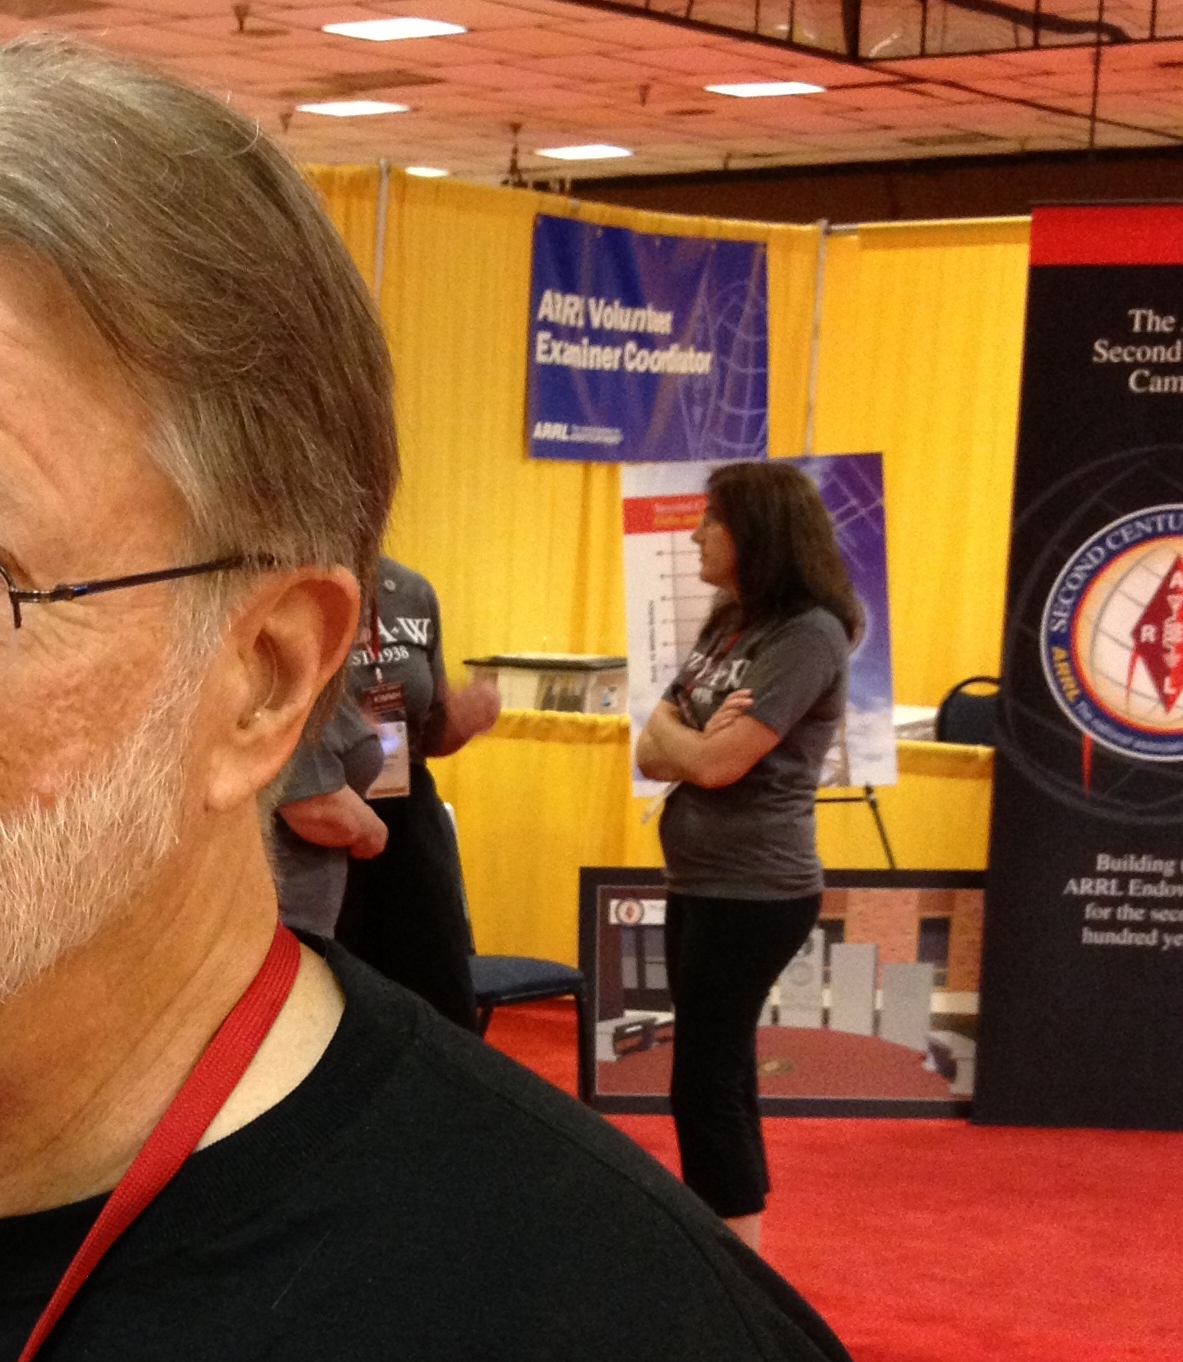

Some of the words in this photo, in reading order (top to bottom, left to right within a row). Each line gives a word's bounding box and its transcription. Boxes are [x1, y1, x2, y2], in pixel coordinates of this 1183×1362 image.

[1128, 308, 1176, 333] The
[1092, 338, 1182, 364] Second
[1050, 545, 1107, 634] SECOND
[1095, 853, 1177, 878] Building
[1062, 878, 1124, 897] ARRL
[1084, 902, 1114, 921] for
[1116, 903, 1146, 921] the
[1081, 926, 1159, 946] hundred
